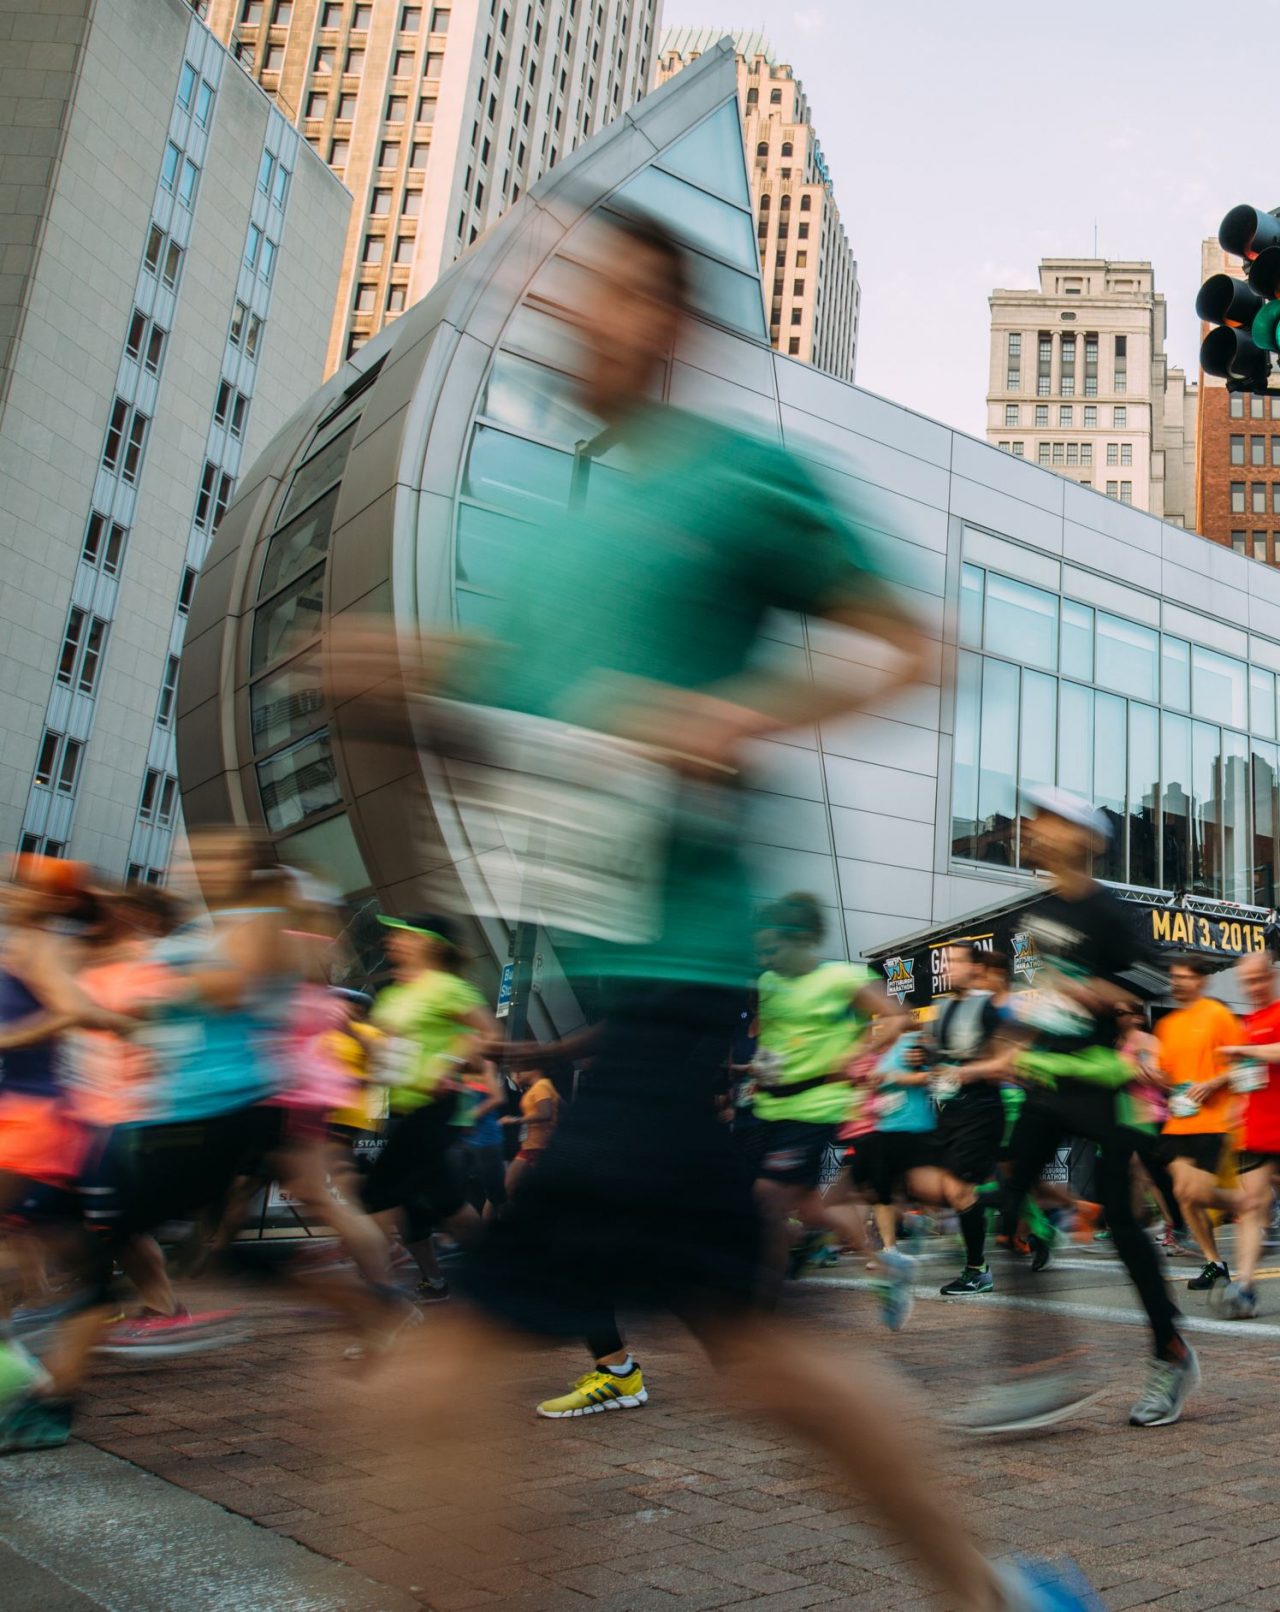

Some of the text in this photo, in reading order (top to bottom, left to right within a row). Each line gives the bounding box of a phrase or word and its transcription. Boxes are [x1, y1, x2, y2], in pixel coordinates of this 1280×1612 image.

[1152, 909, 1266, 954] MAY 3, 2015
